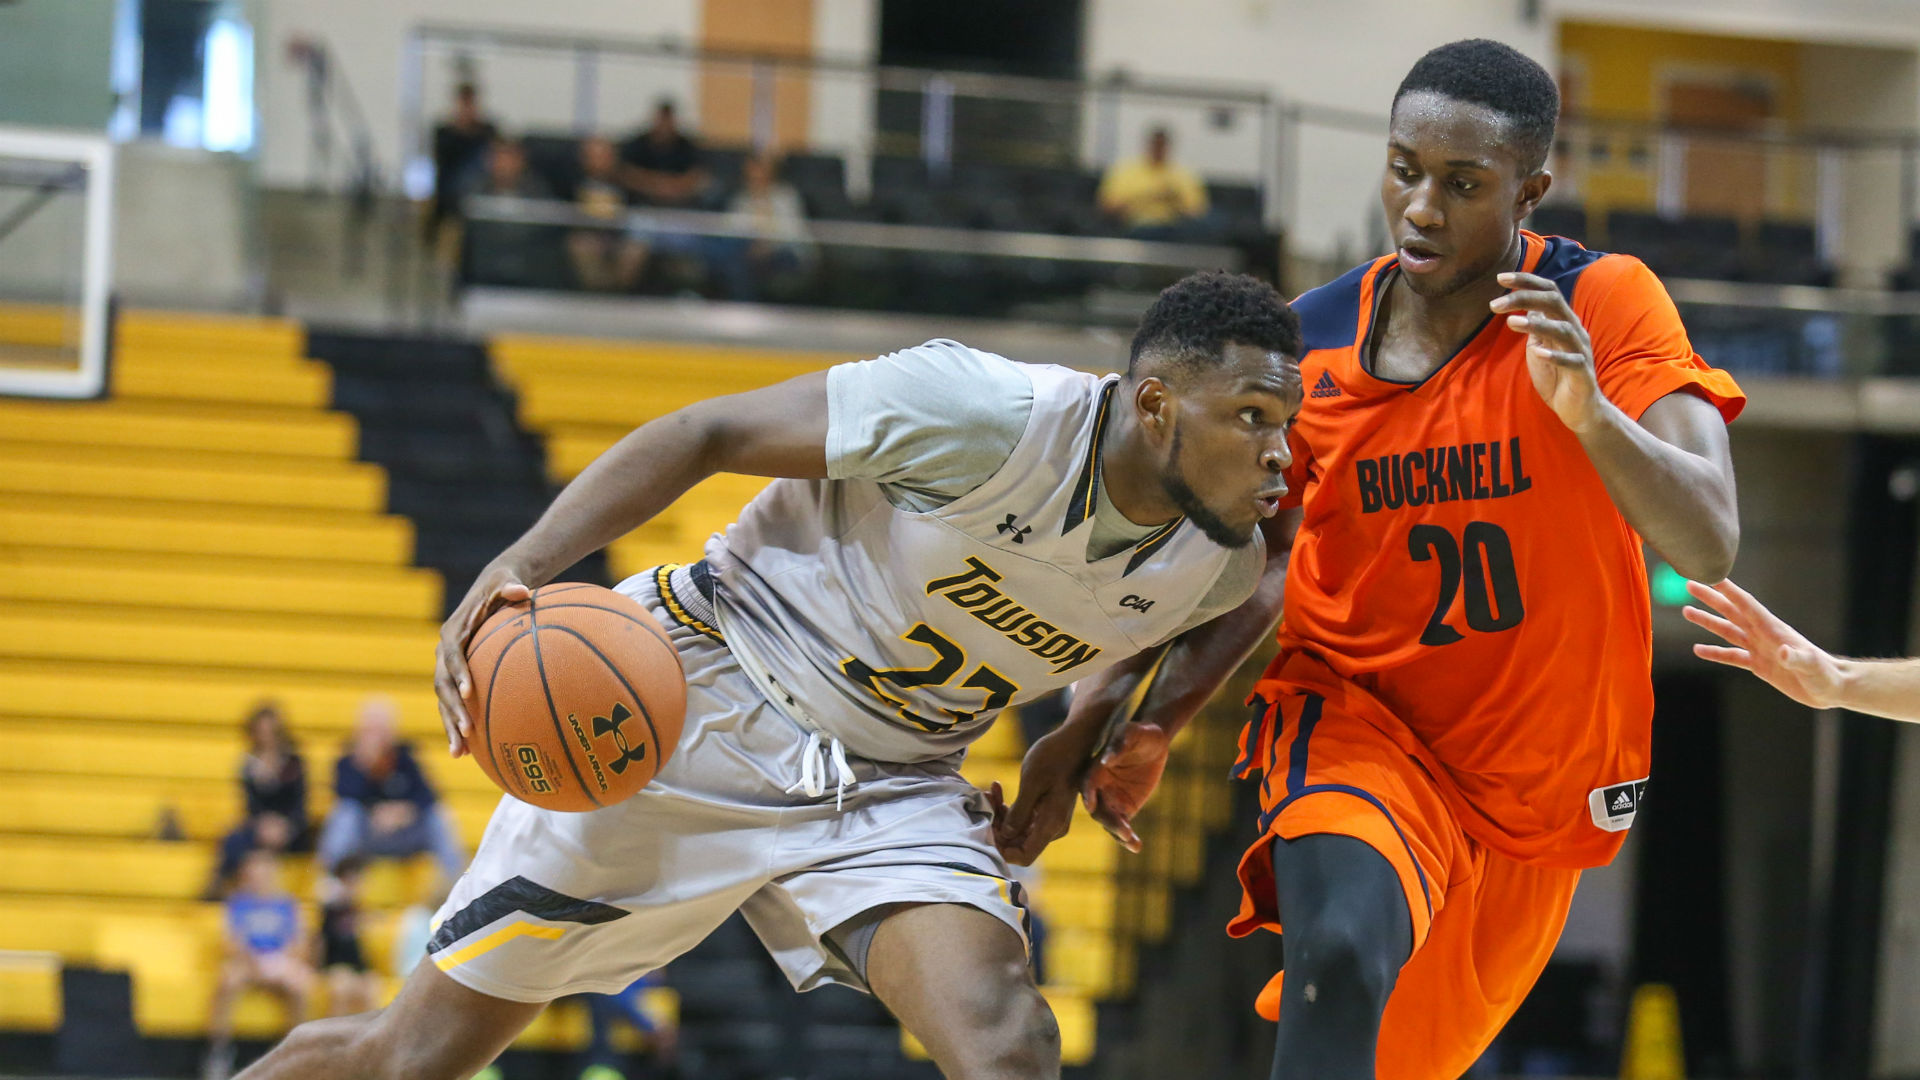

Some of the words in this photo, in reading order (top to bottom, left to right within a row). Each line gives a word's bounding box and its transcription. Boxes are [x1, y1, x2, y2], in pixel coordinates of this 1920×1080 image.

[1311, 387, 1341, 398] adidas
[1356, 436, 1532, 513] BUCKNELL
[926, 555, 1104, 675] TOWSON
[1408, 521, 1525, 646] 20
[517, 746, 552, 793] 695
[567, 713, 592, 752] UNDER
[588, 754, 608, 792] ARMOUR
[1612, 801, 1633, 811] adidas
